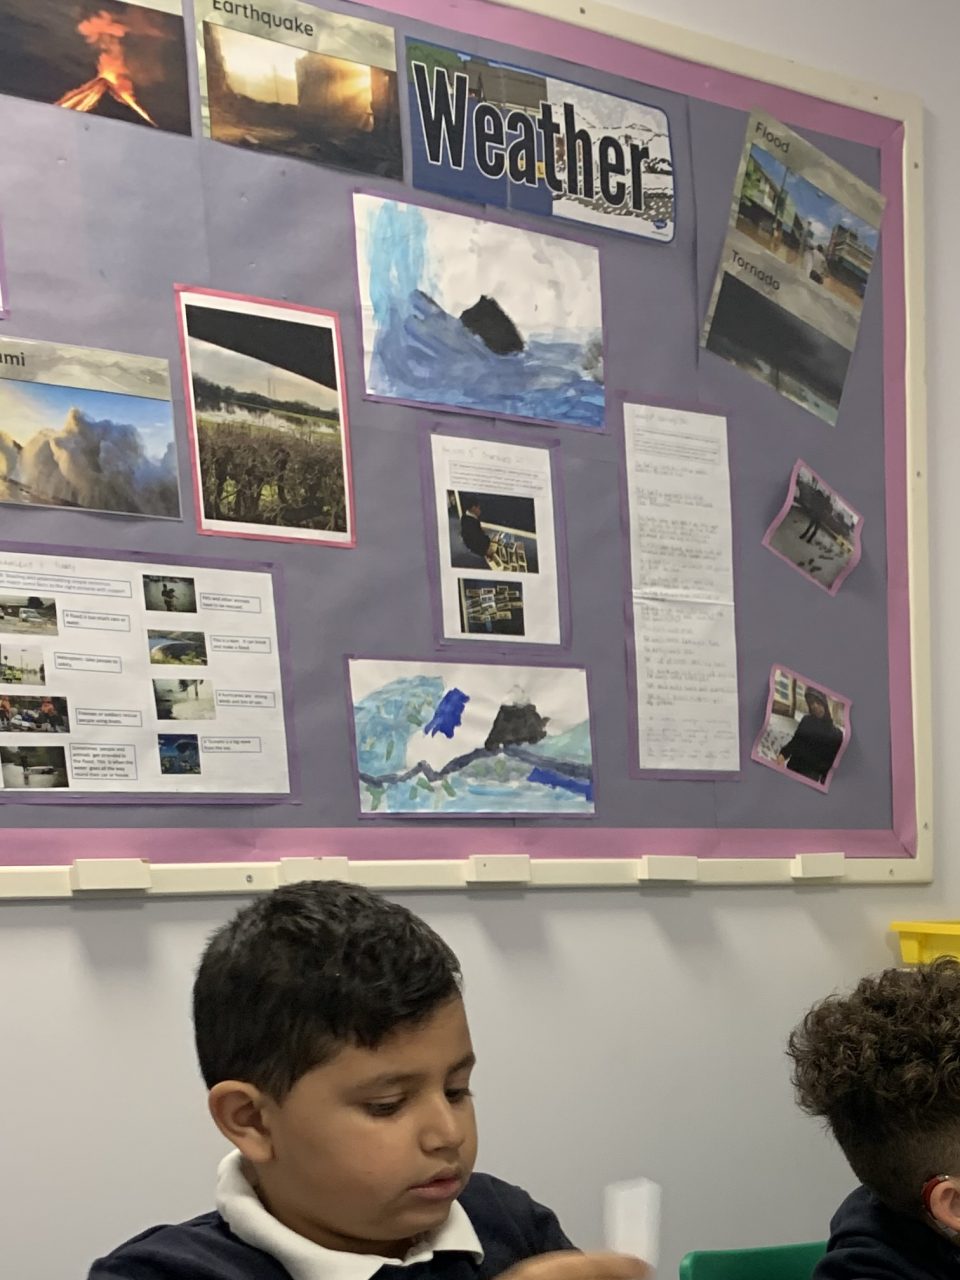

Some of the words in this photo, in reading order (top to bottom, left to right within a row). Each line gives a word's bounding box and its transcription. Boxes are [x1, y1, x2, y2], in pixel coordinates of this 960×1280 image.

[212, 0, 314, 36] Earthquake
[412, 61, 650, 212] Weather
[755, 122, 790, 154] Flood
[732, 249, 781, 291] Tornado
